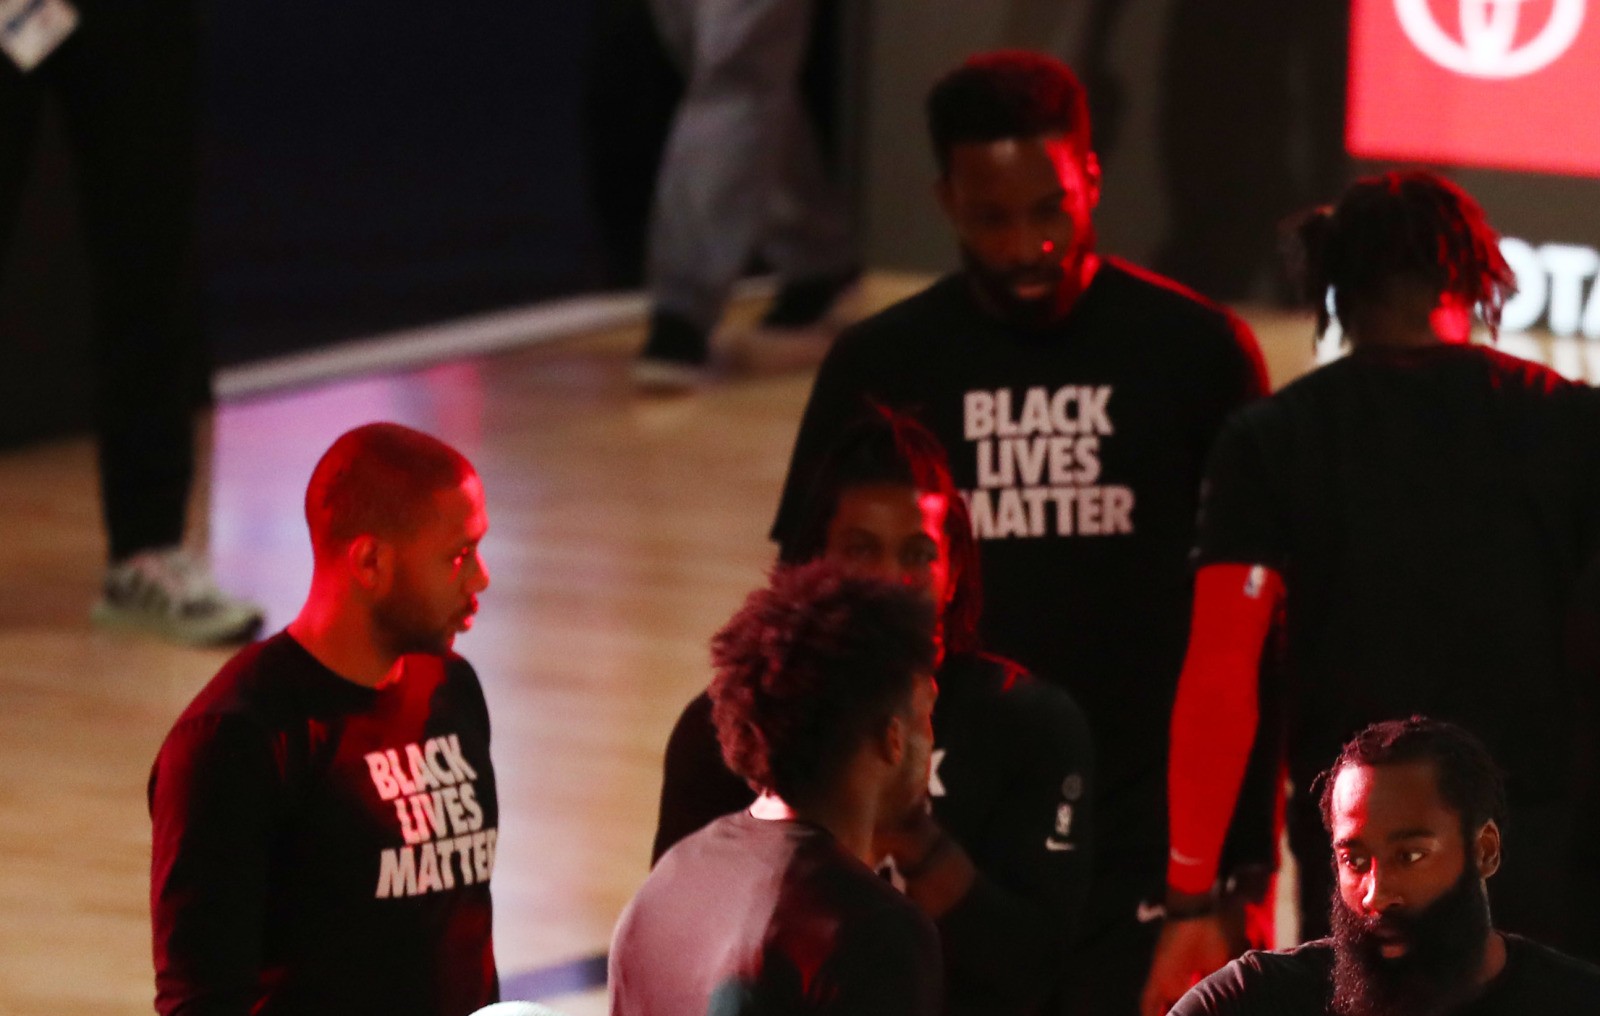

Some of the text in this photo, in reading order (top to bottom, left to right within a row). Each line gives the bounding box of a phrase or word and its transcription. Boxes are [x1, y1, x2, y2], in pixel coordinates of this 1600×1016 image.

[963, 385, 1113, 441] BLACK
[976, 436, 1102, 489] LIVES
[957, 484, 1135, 540] MATTER
[364, 733, 478, 801] BLACK
[395, 783, 484, 845] LIVES
